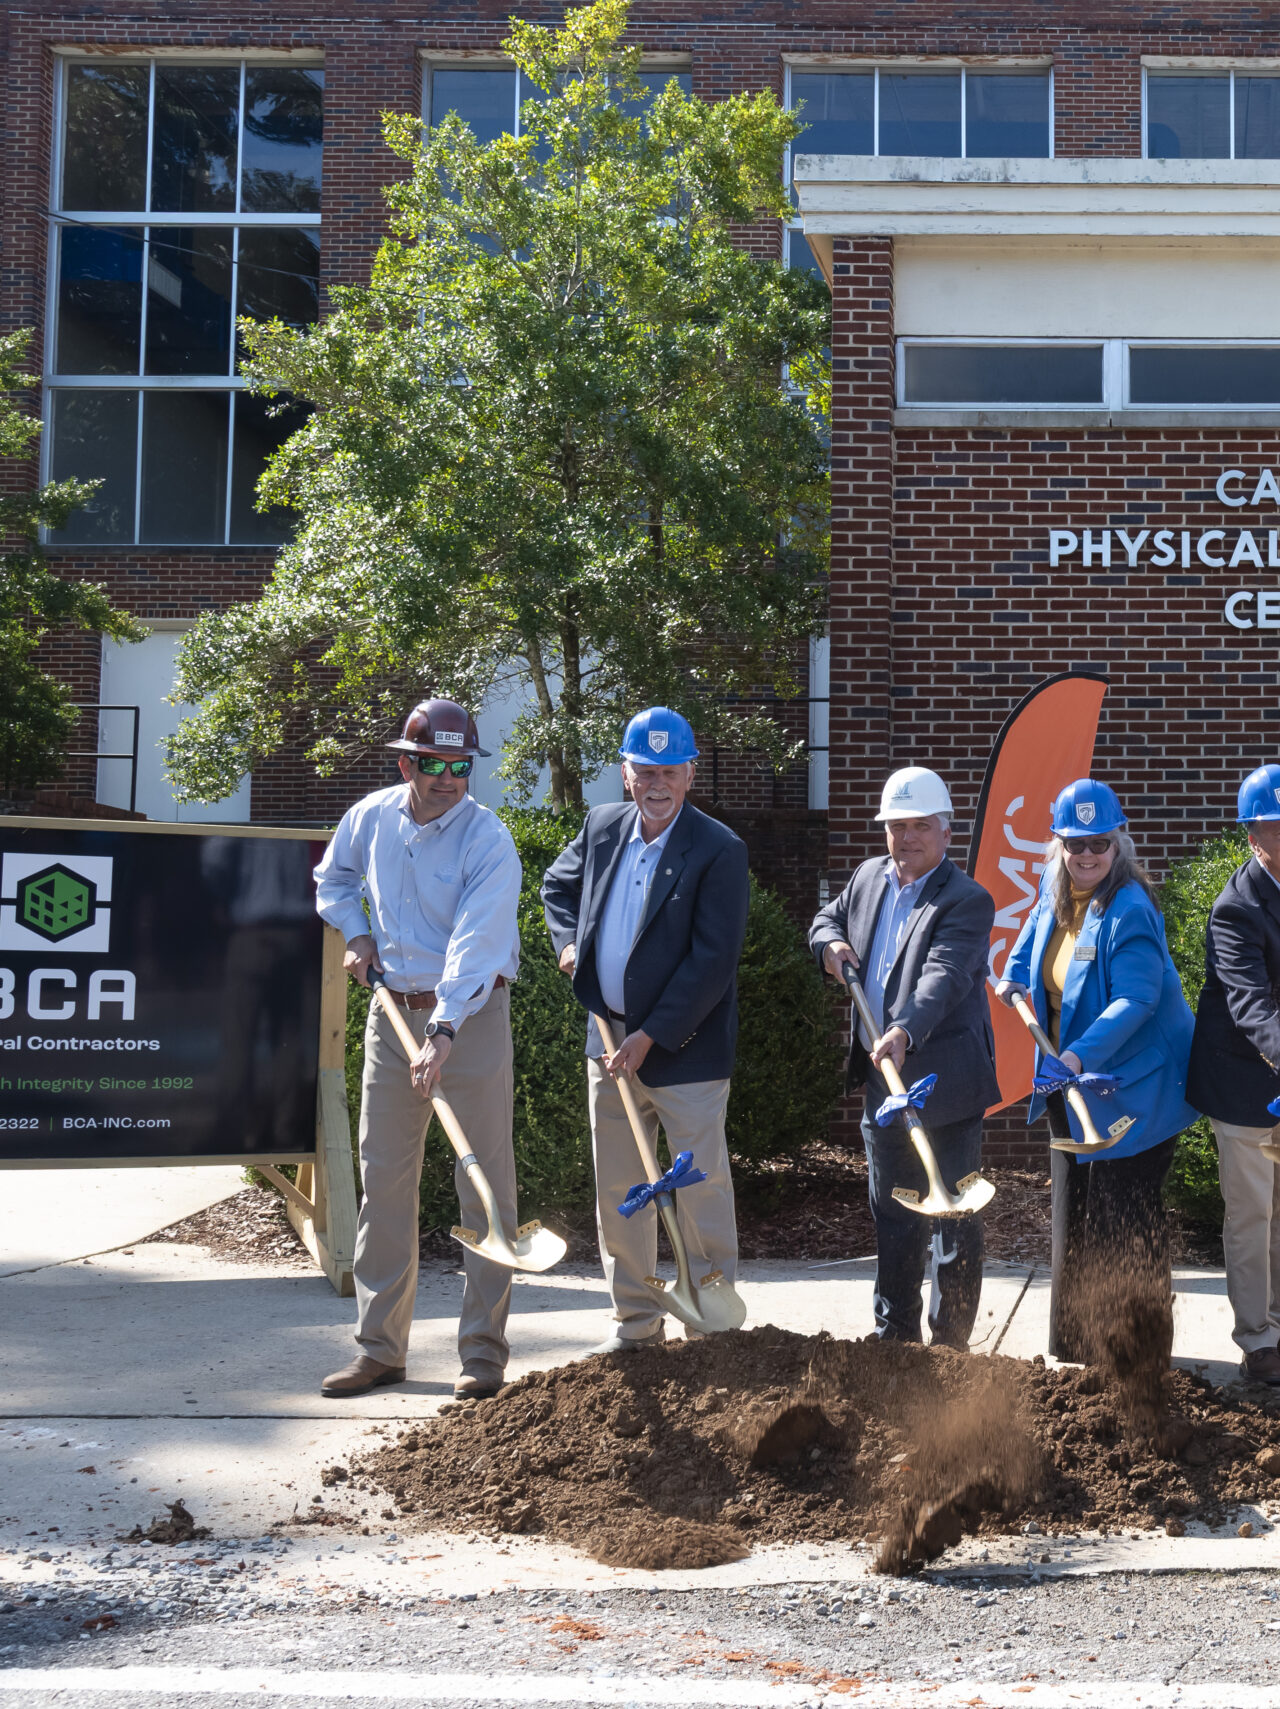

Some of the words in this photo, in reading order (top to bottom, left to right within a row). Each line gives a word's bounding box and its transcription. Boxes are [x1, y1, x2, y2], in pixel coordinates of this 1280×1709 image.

[445, 733, 462, 741] BCA
[27, 1036, 161, 1051] Contractors
[17, 1077, 94, 1093] Integrity
[99, 1077, 147, 1090] Since
[151, 1077, 194, 1090] 1992
[63, 1117, 171, 1129] BCA-INC.com
